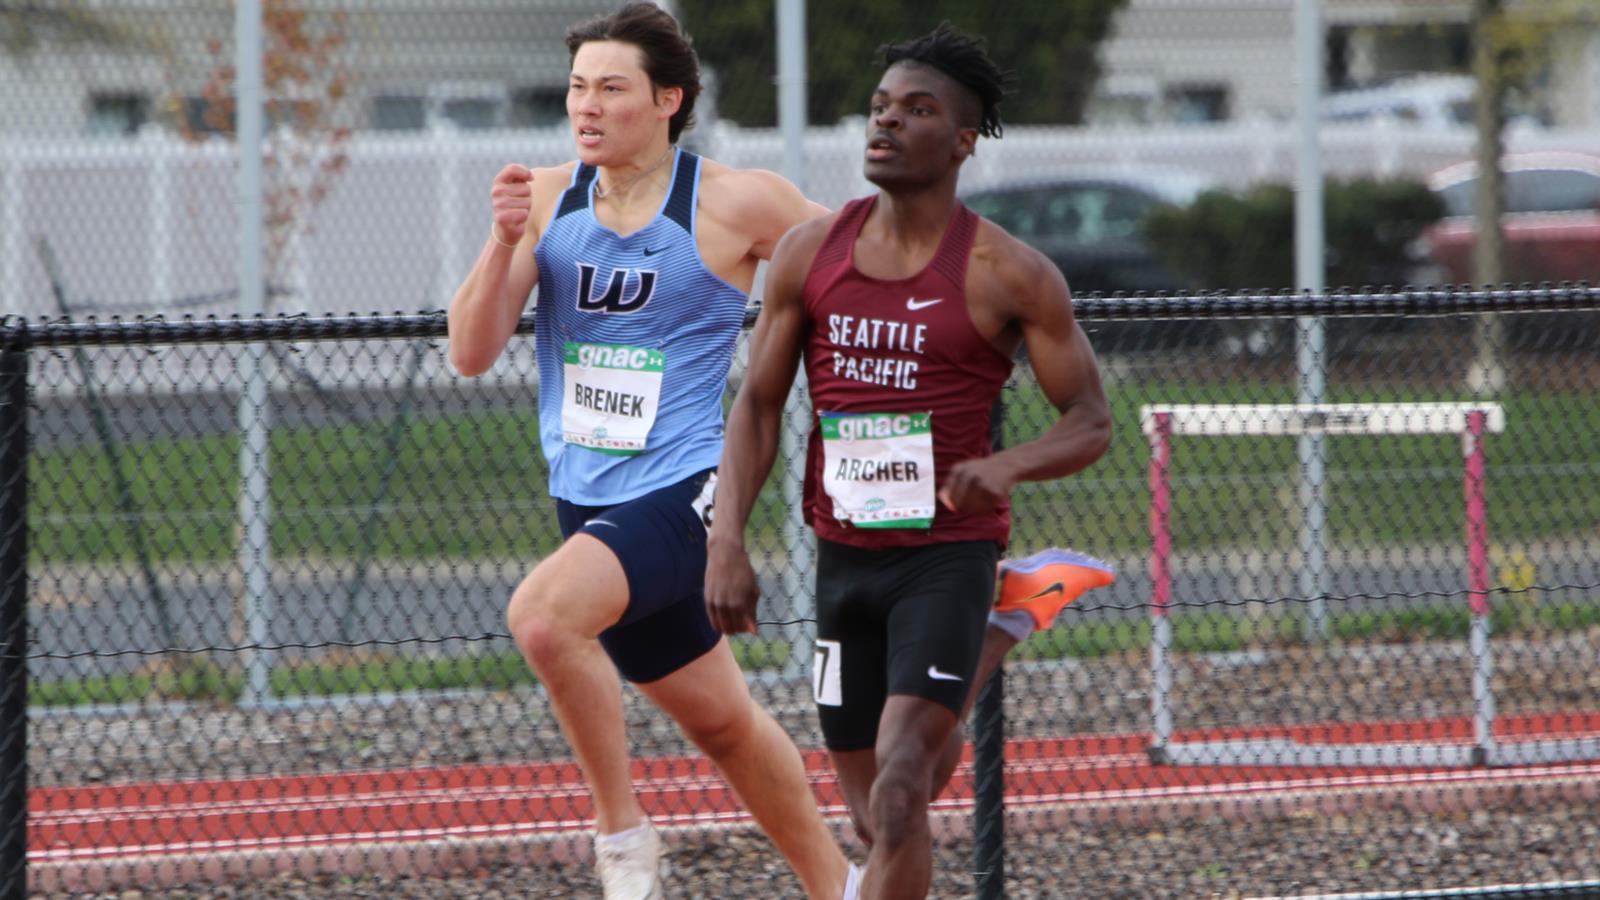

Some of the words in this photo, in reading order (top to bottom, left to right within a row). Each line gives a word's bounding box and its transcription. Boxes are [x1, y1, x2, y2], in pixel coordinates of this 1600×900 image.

[576, 262, 657, 314] W
[829, 314, 927, 354] SEATTLE
[578, 344, 648, 370] gnac
[833, 352, 919, 390] PACIFIC
[575, 383, 645, 418] BRENEK
[838, 415, 911, 442] gnac
[836, 458, 919, 482] ARCHER
